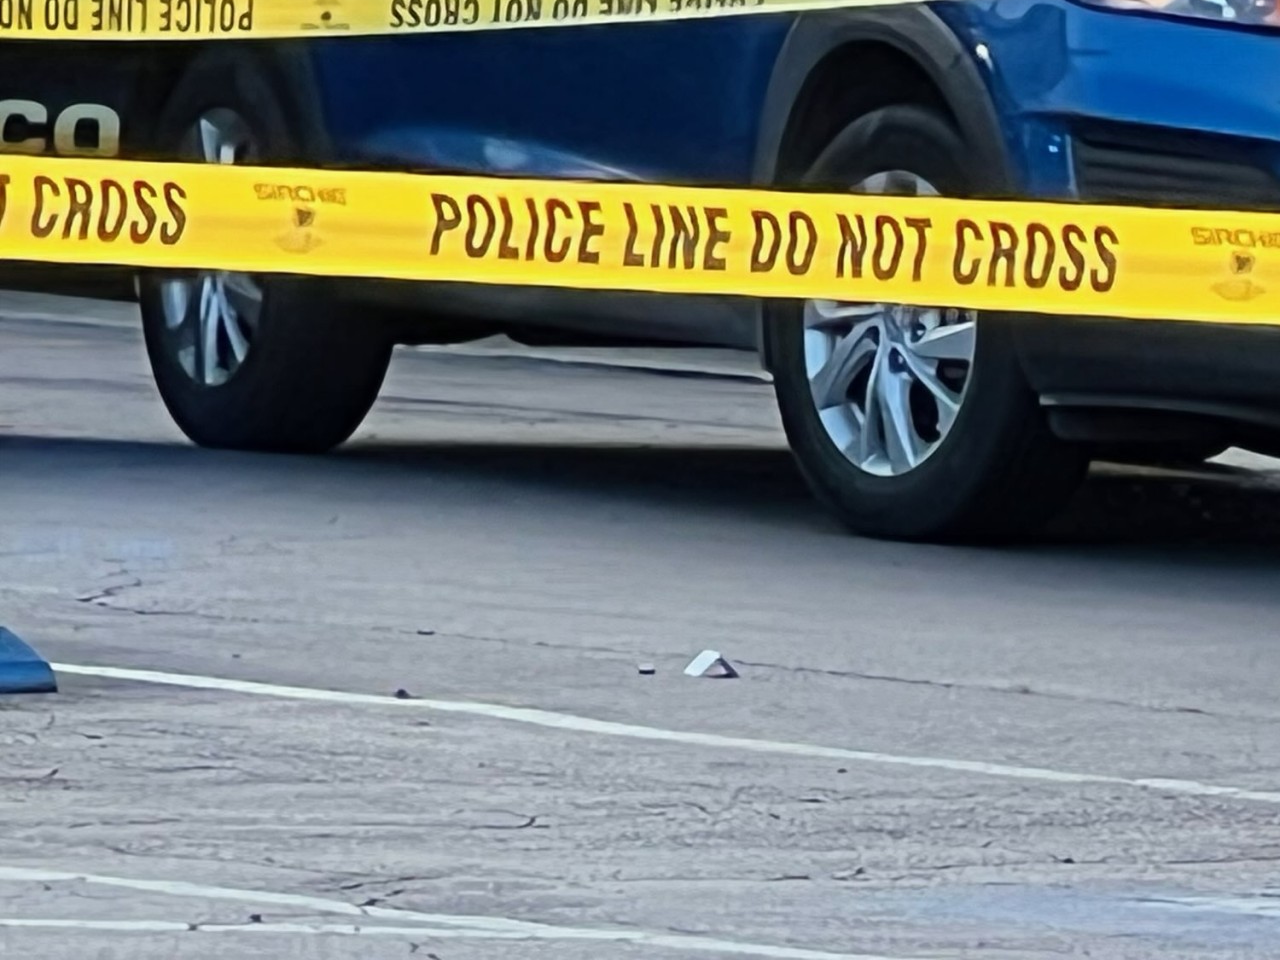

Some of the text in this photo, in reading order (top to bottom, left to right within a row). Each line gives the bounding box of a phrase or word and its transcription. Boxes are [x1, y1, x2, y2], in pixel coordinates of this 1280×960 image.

[31, 175, 187, 245] CROSS
[430, 193, 1120, 293] POLICE LINE DO NOT CROSS
